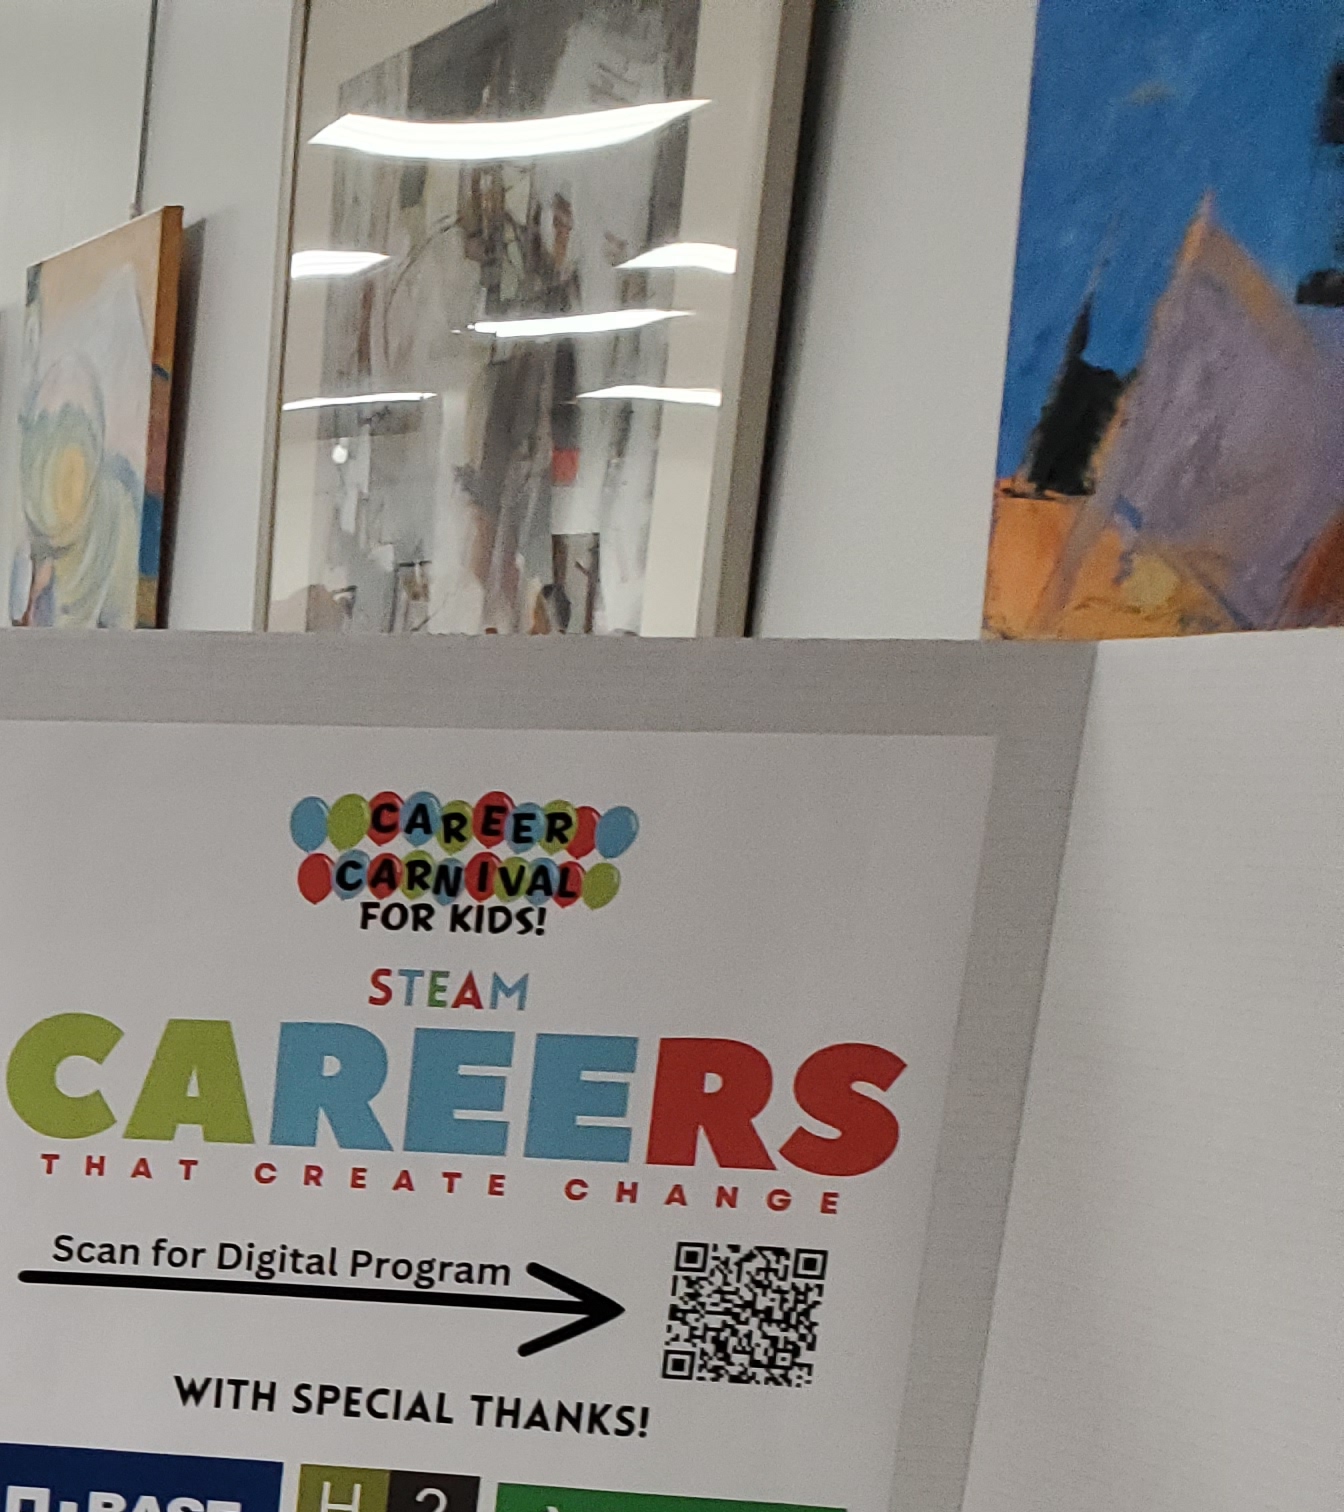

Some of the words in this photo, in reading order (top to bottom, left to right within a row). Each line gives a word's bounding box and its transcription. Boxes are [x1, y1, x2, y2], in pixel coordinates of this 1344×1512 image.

[372, 792, 576, 846] CAREER
[334, 859, 582, 901] CARNIVAL
[359, 900, 434, 933] FOR
[449, 903, 547, 937] KIDS!
[368, 968, 528, 1012] STEAM
[5, 1010, 909, 1178] CAREERS
[41, 1152, 200, 1183] THAT
[254, 1161, 508, 1197] CREATE
[564, 1177, 841, 1217] CHANGE
[52, 1233, 141, 1266] Scan
[152, 1237, 207, 1269] for
[216, 1241, 339, 1281] Digital
[349, 1248, 513, 1291] Program
[173, 1374, 278, 1413] WITH
[291, 1382, 454, 1425] SPECIAL
[470, 1394, 651, 1438] THANKS!
